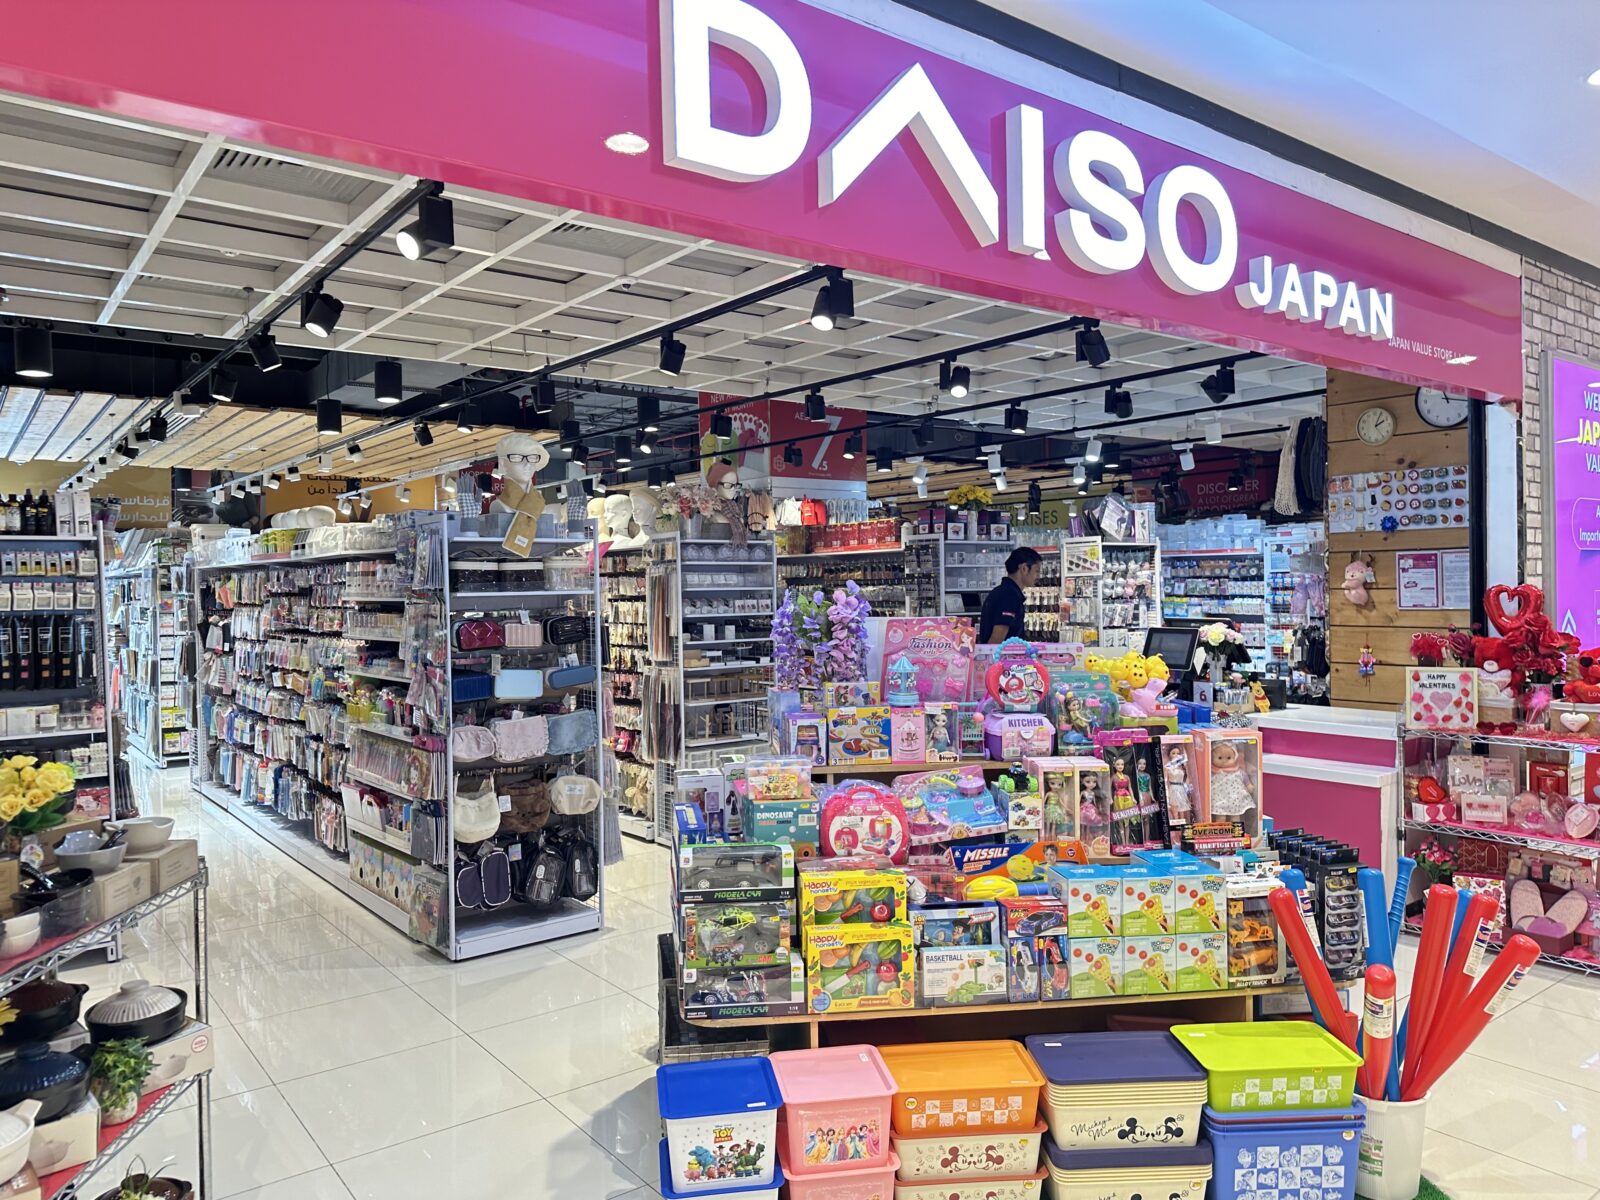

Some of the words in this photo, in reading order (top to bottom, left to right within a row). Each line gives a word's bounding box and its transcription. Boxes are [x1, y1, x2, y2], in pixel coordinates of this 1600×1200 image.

[1238, 254, 1394, 341] JAPAN
[1388, 335, 1410, 351] JAPAN
[1411, 340, 1432, 357] VALUE
[1433, 346, 1453, 361] STORE
[1197, 479, 1260, 496] DISCER
[909, 637, 953, 650] Fashion
[1427, 674, 1447, 682] HAPPY
[1418, 682, 1456, 690] VALENTINES
[1008, 717, 1044, 729] KITCHEN
[756, 811, 794, 820] DINOSAUR
[963, 847, 1010, 862] MISSILE
[804, 881, 832, 890] Happy
[809, 935, 837, 944] Happy
[925, 953, 964, 963] BASKETBALL
[713, 1127, 735, 1138] TOY
